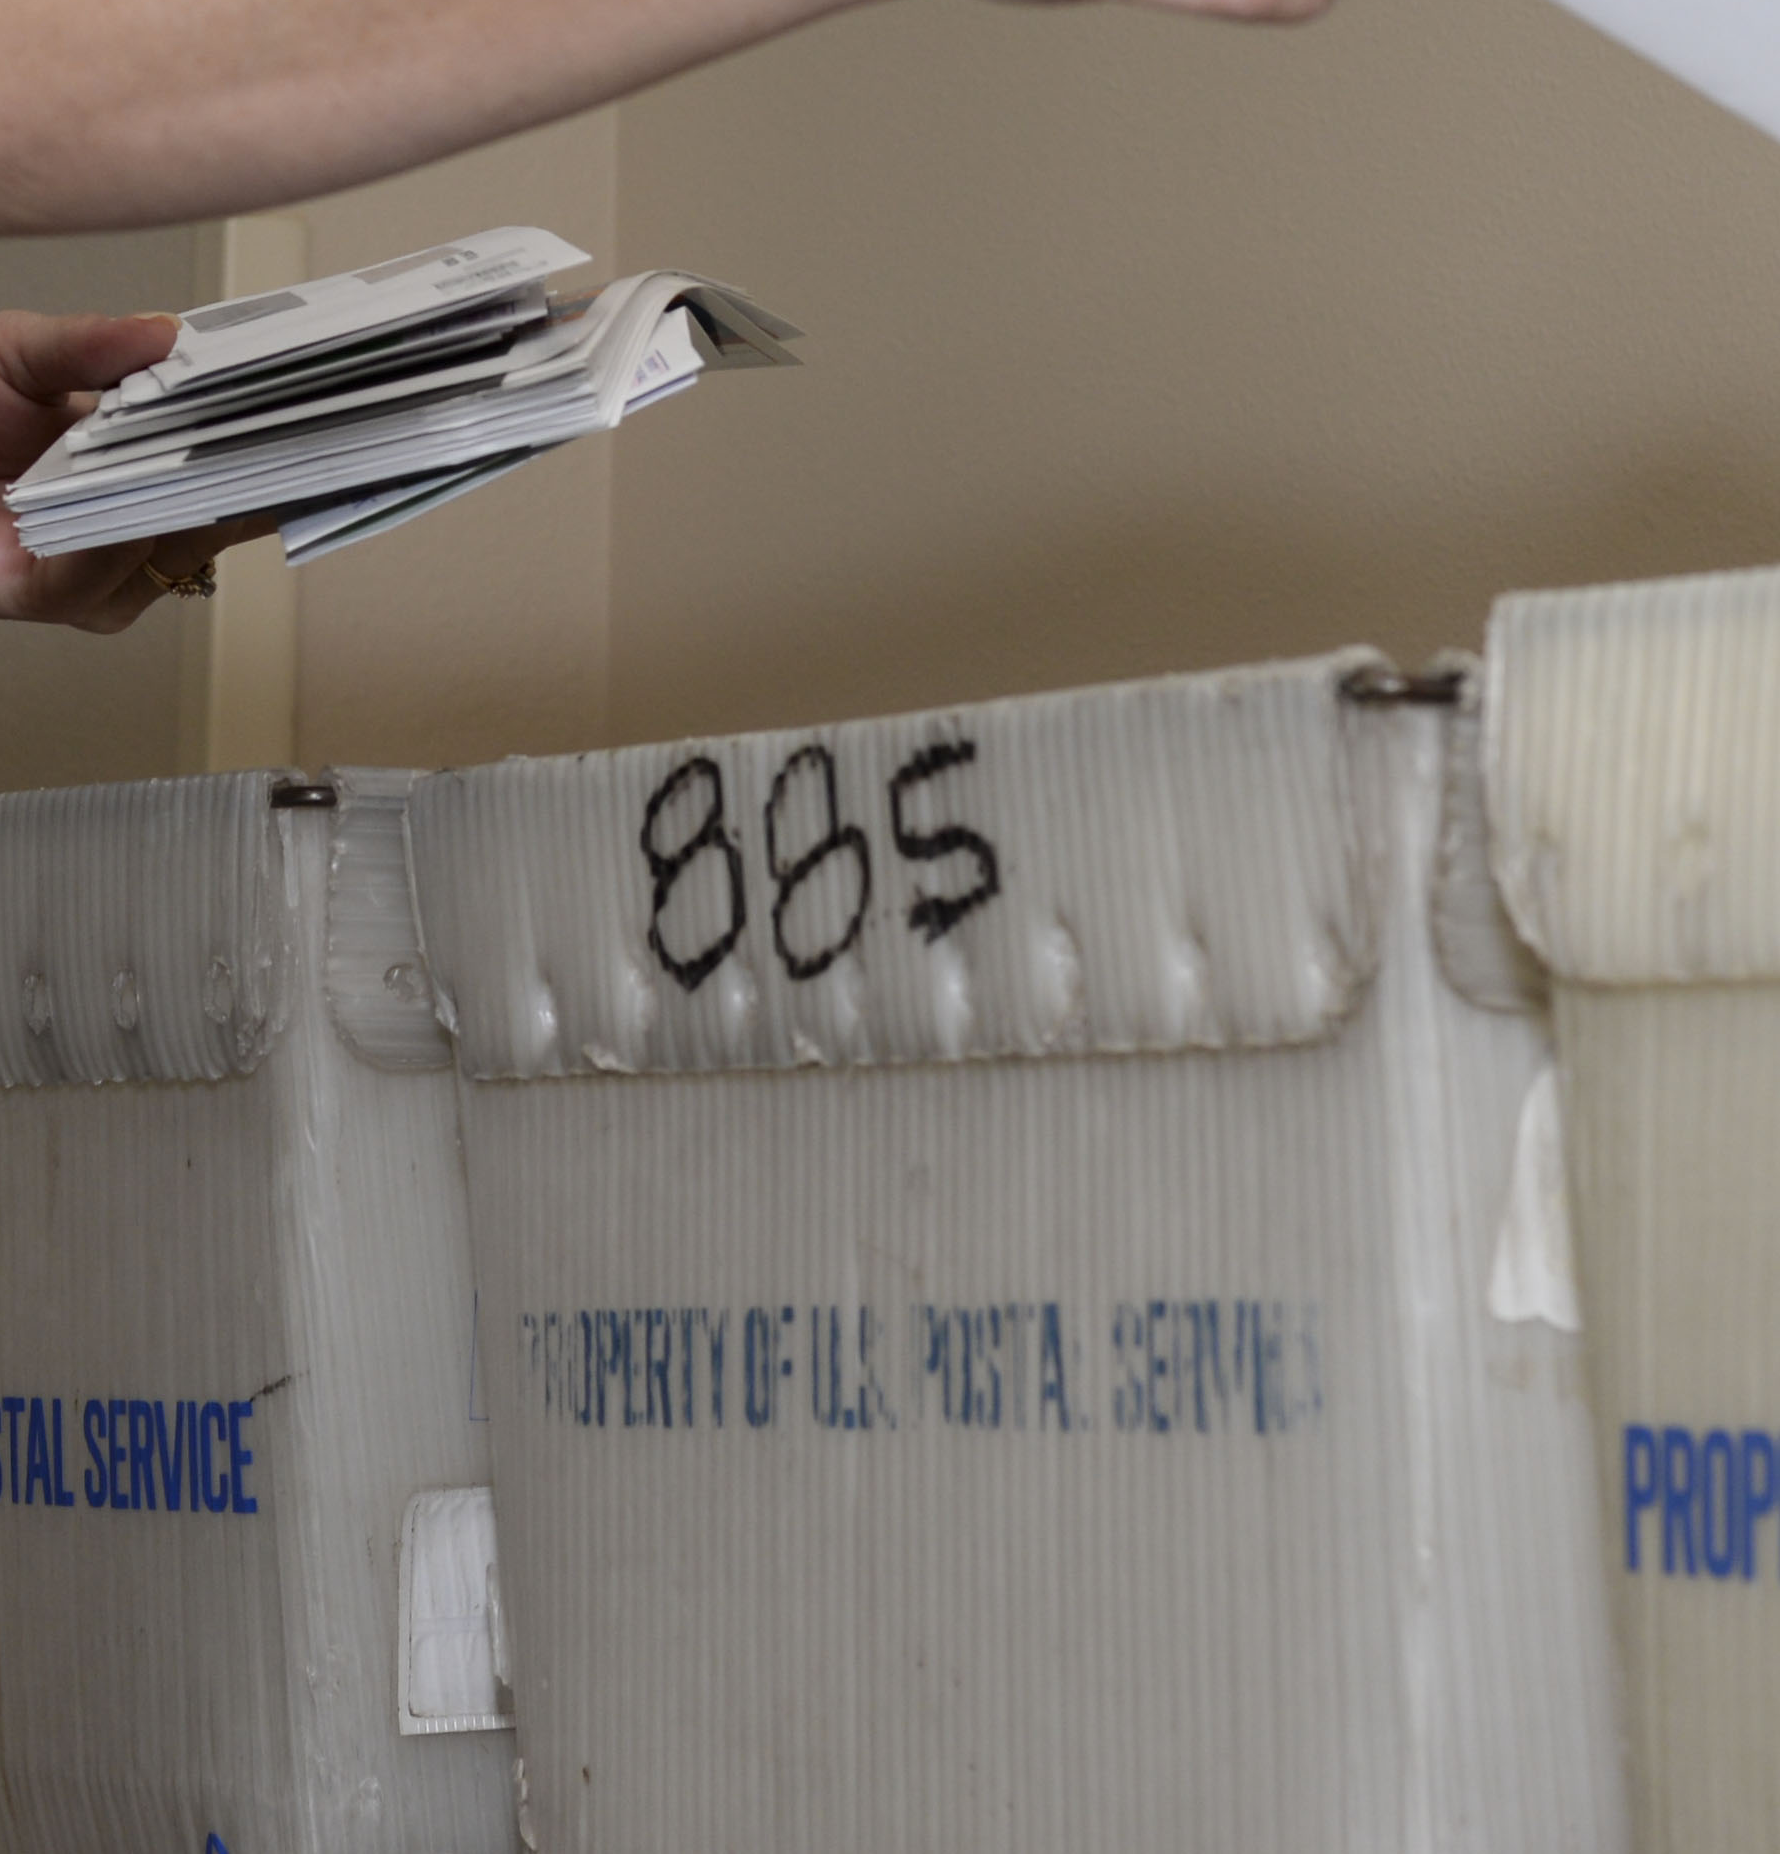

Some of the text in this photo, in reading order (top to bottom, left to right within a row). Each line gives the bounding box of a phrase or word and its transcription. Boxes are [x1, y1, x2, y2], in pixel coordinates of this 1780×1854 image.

[640, 736, 1001, 992] 885
[744, 1304, 796, 1430] OF
[84, 1399, 258, 1516] SERVICE
